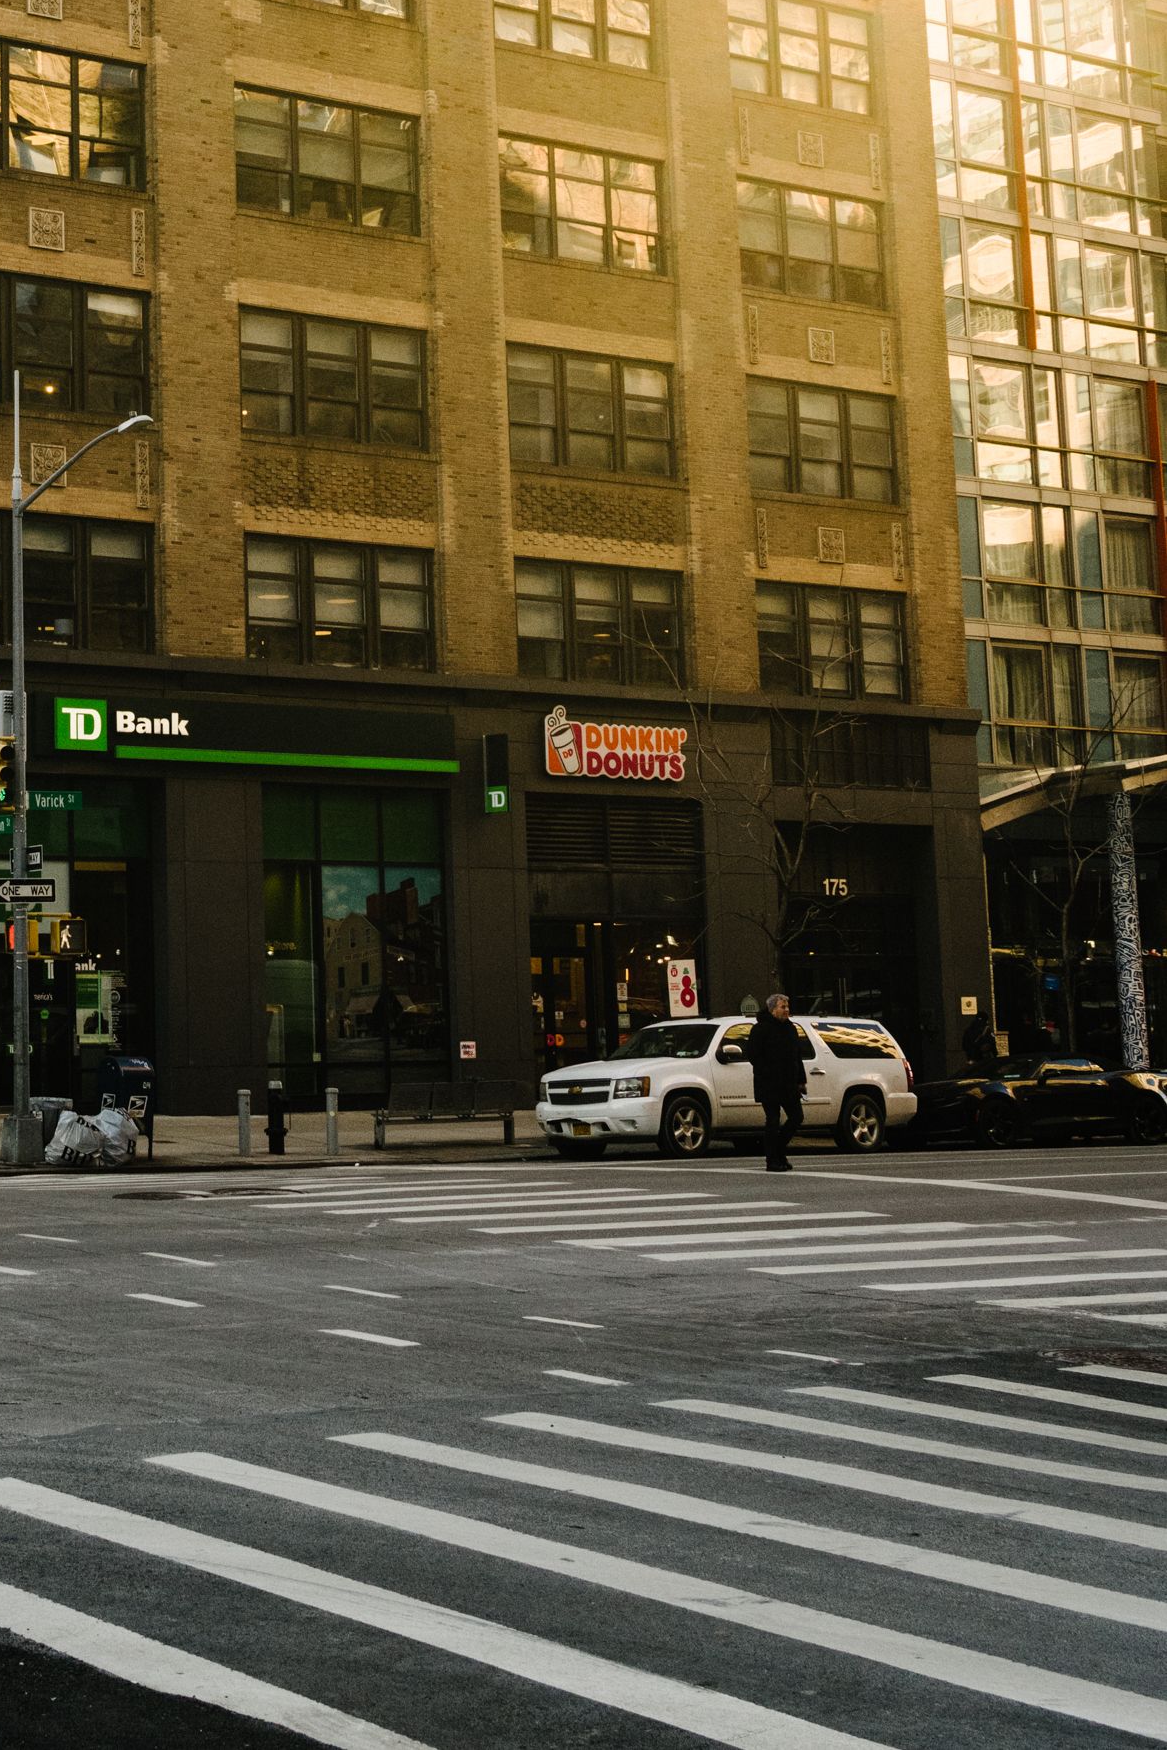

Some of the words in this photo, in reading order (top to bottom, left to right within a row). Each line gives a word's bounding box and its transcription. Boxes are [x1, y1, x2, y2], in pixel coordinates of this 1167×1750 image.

[61, 707, 102, 741] TD
[116, 710, 189, 736] Bank
[585, 725, 685, 753] DUNKIN'
[586, 751, 683, 779] DONUTS
[34, 793, 65, 808] Varick
[67, 793, 75, 803] St
[488, 790, 505, 808] TD
[1, 886, 21, 896] ONE
[31, 886, 50, 895] WAY
[822, 878, 848, 896] 175
[75, 959, 96, 971] ank
[546, 1033, 565, 1047] DD
